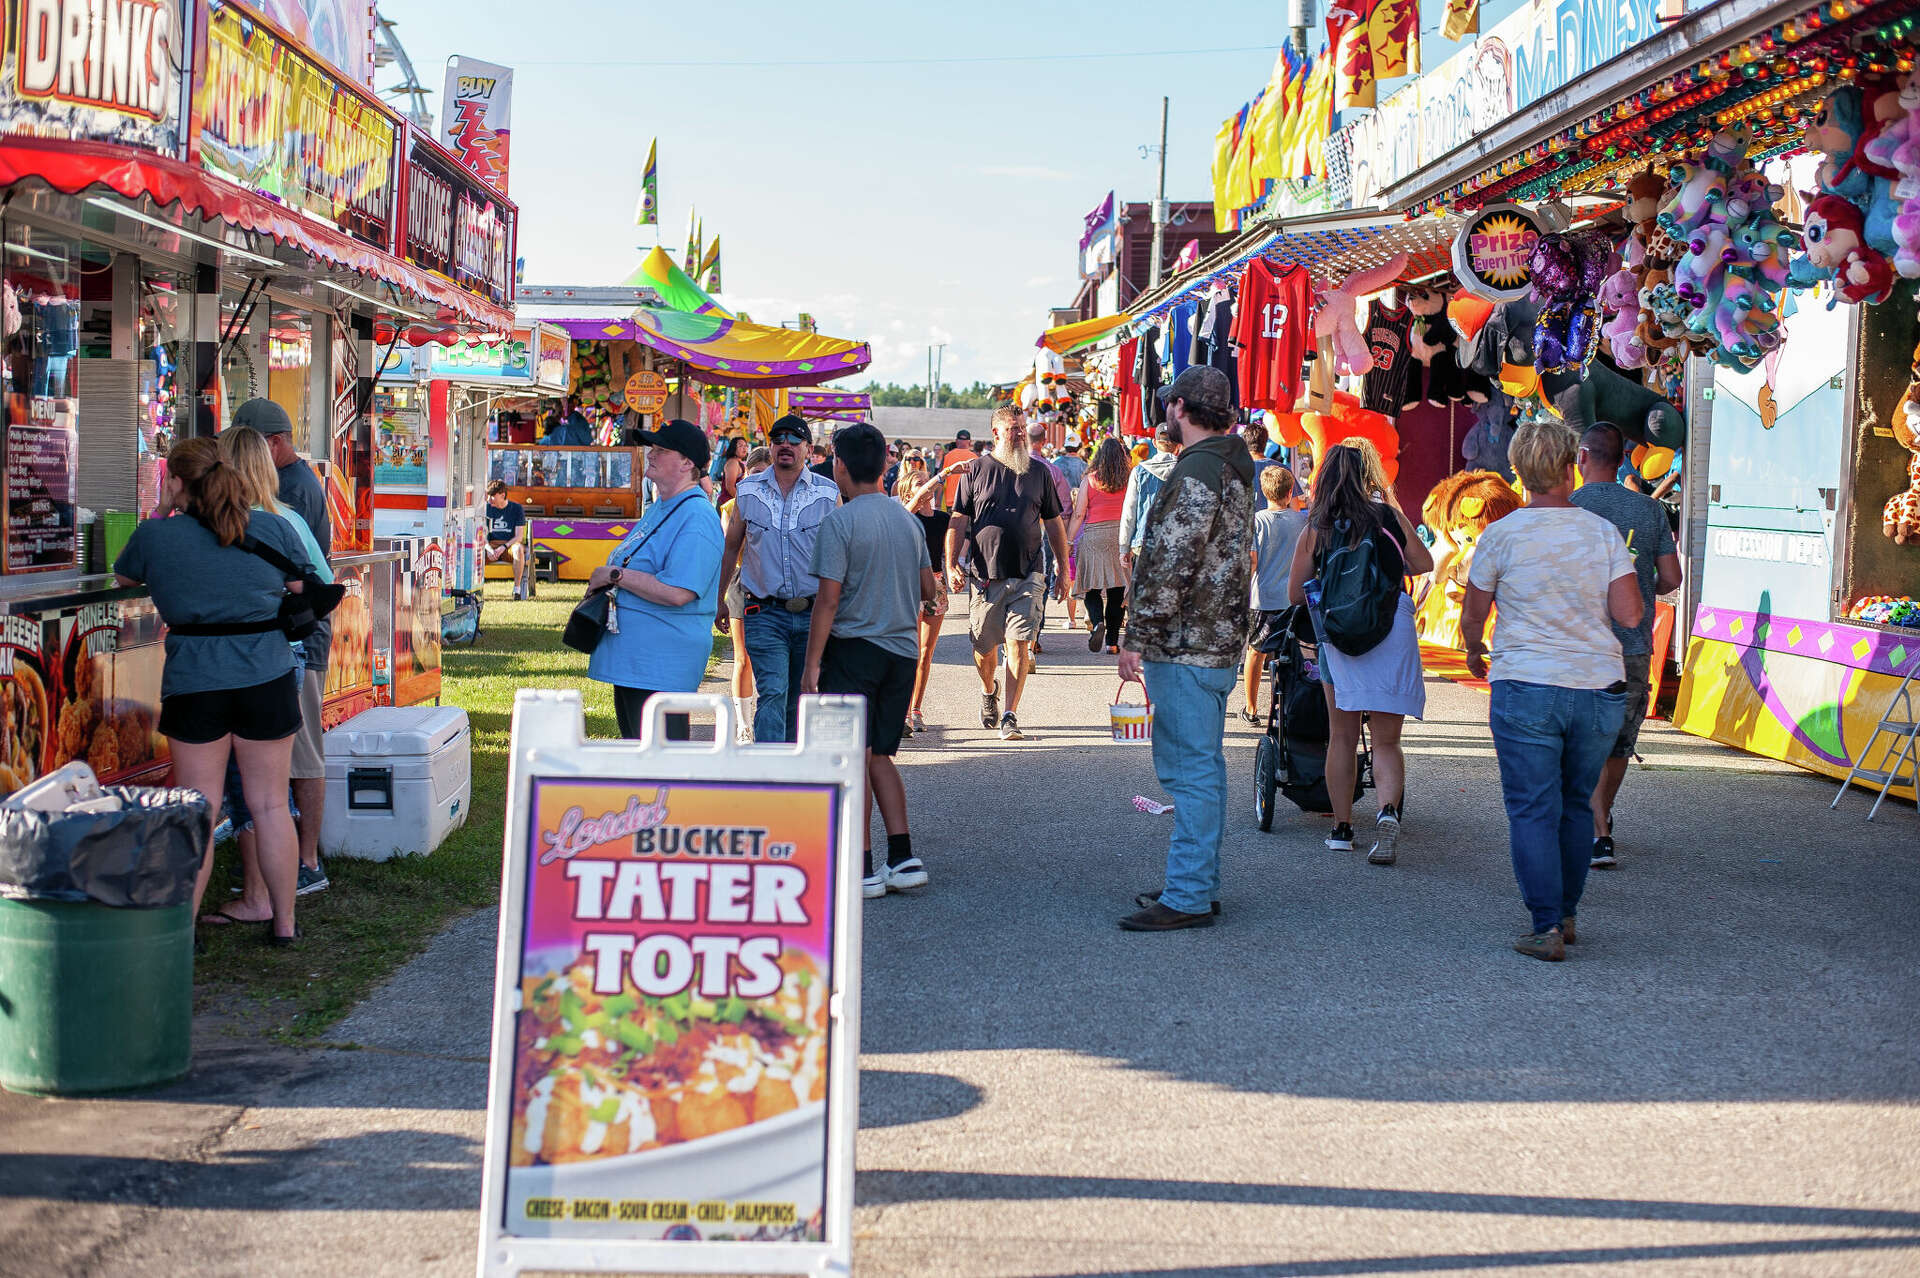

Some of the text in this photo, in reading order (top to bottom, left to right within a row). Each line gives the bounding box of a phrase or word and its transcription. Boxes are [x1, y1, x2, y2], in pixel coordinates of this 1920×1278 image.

[23, 0, 170, 116] DRINKS
[457, 76, 496, 99] BUY
[1471, 230, 1538, 254] Prize
[1475, 255, 1507, 272] Every
[1261, 303, 1288, 339] 12
[1372, 345, 1394, 371] 23
[31, 400, 56, 420] MENU
[338, 394, 356, 426] GRILL
[77, 602, 124, 636] BONELESS
[86, 629, 117, 659] WINGS
[540, 785, 670, 865] Loaded
[635, 826, 794, 859] BUCKET OF
[565, 859, 811, 925] TATER
[583, 933, 784, 998] TOTS
[526, 1199, 564, 1219] CHEESE
[573, 1200, 610, 1219] BACON
[618, 1201, 648, 1220] SOUR
[652, 1202, 688, 1221] CREAM
[697, 1203, 726, 1221] CHILI
